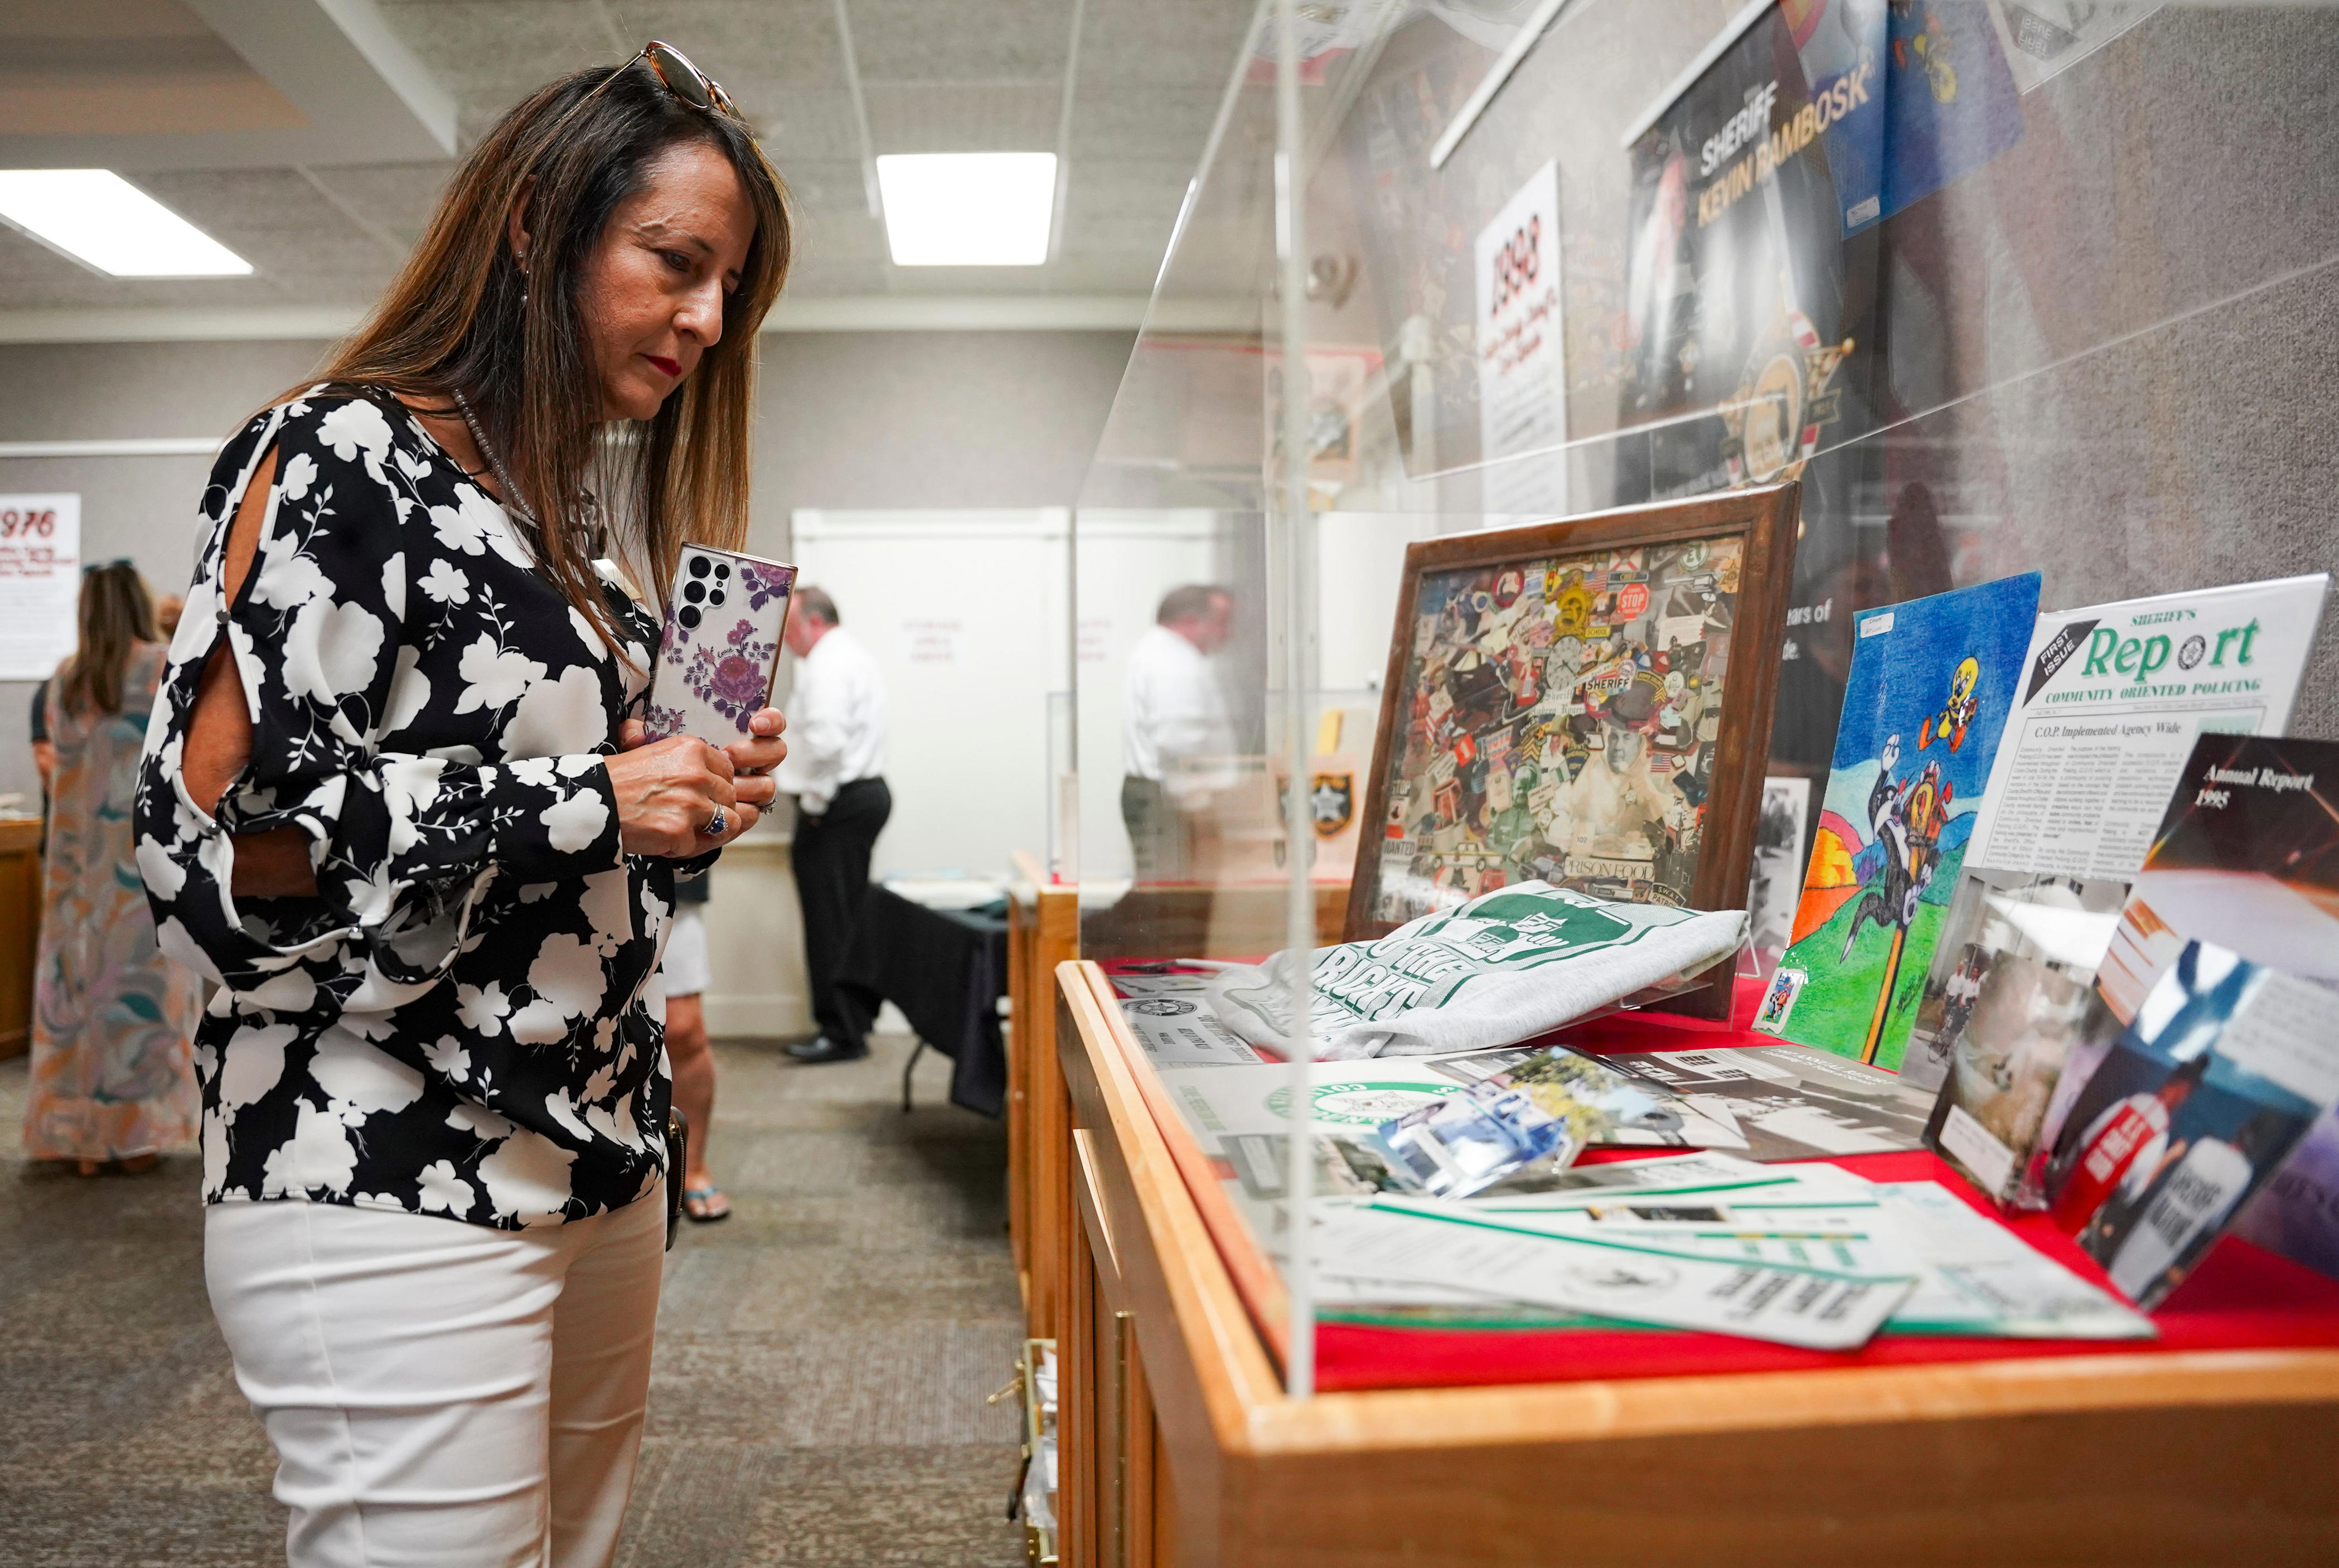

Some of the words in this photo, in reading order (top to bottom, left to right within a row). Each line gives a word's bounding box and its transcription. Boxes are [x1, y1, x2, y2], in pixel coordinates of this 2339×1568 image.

[1701, 80, 1779, 176] SHERIFF
[1698, 154, 1755, 228] KEVIN
[1756, 63, 1867, 184] RAMBOSK
[0, 509, 57, 539] 976
[1621, 593, 1645, 608] STOP
[1814, 598, 1833, 623] of
[2131, 608, 2198, 627] SHERIFF'S
[1586, 627, 1607, 636] SCHOOL
[2041, 628, 2070, 664] FIRST
[2043, 640, 2076, 676] ISSUE
[1587, 678, 1629, 690] SHERIFF
[2045, 688, 2114, 704] COMMUNITY
[2120, 684, 2186, 699] ORIENTED
[2192, 679, 2261, 695] POLICING
[2035, 727, 2060, 738] C.O.P.
[2062, 725, 2117, 738] Implemented
[2120, 724, 2152, 739] Agency
[2156, 722, 2182, 734] Wide
[1460, 741, 1470, 759] 1
[2203, 763, 2258, 786] Annual
[2258, 767, 2314, 795] Report
[1384, 840, 1416, 855] WANTED
[1563, 860, 1611, 876] PRISON
[1615, 864, 1655, 879] FOOD
[1796, 1054, 1844, 1070] ANNUAL
[1844, 1069, 1896, 1085] REPORT
